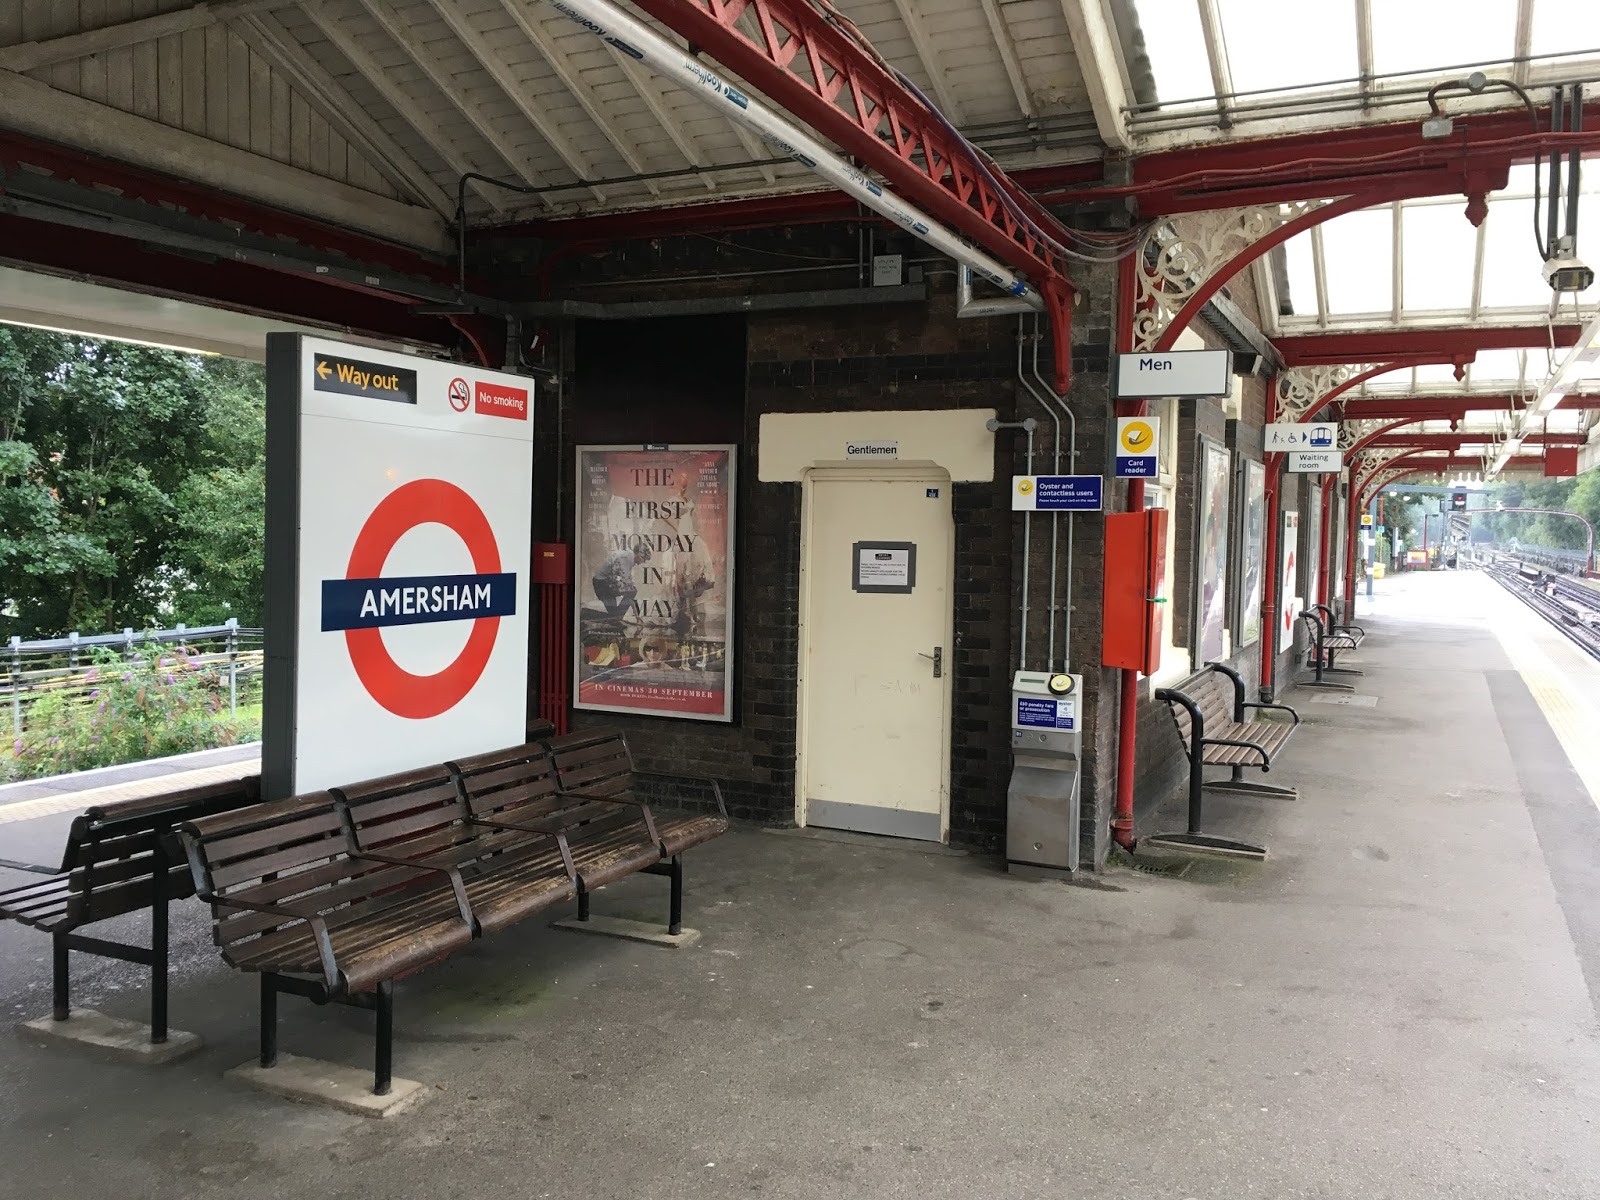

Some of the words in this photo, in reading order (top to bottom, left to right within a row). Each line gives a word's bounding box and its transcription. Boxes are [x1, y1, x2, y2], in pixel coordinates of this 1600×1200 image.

[1139, 358, 1172, 371] Men
[336, 363, 370, 390] Way
[373, 374, 399, 391] out
[479, 391, 492, 404] No
[493, 395, 524, 410] smoking
[847, 445, 897, 455] Gentlemen
[1299, 454, 1329, 463] Waiting
[630, 468, 675, 487] THE
[1039, 483, 1061, 491] Oyster
[625, 500, 685, 520] FIRST
[612, 533, 698, 553] MONDAY
[642, 566, 663, 585] IN
[359, 583, 491, 618] AMERSHAM
[632, 599, 677, 618] MAY
[594, 683, 602, 691] IN
[607, 684, 644, 694] CINEMAS
[661, 688, 713, 699] SEPTEMBER
